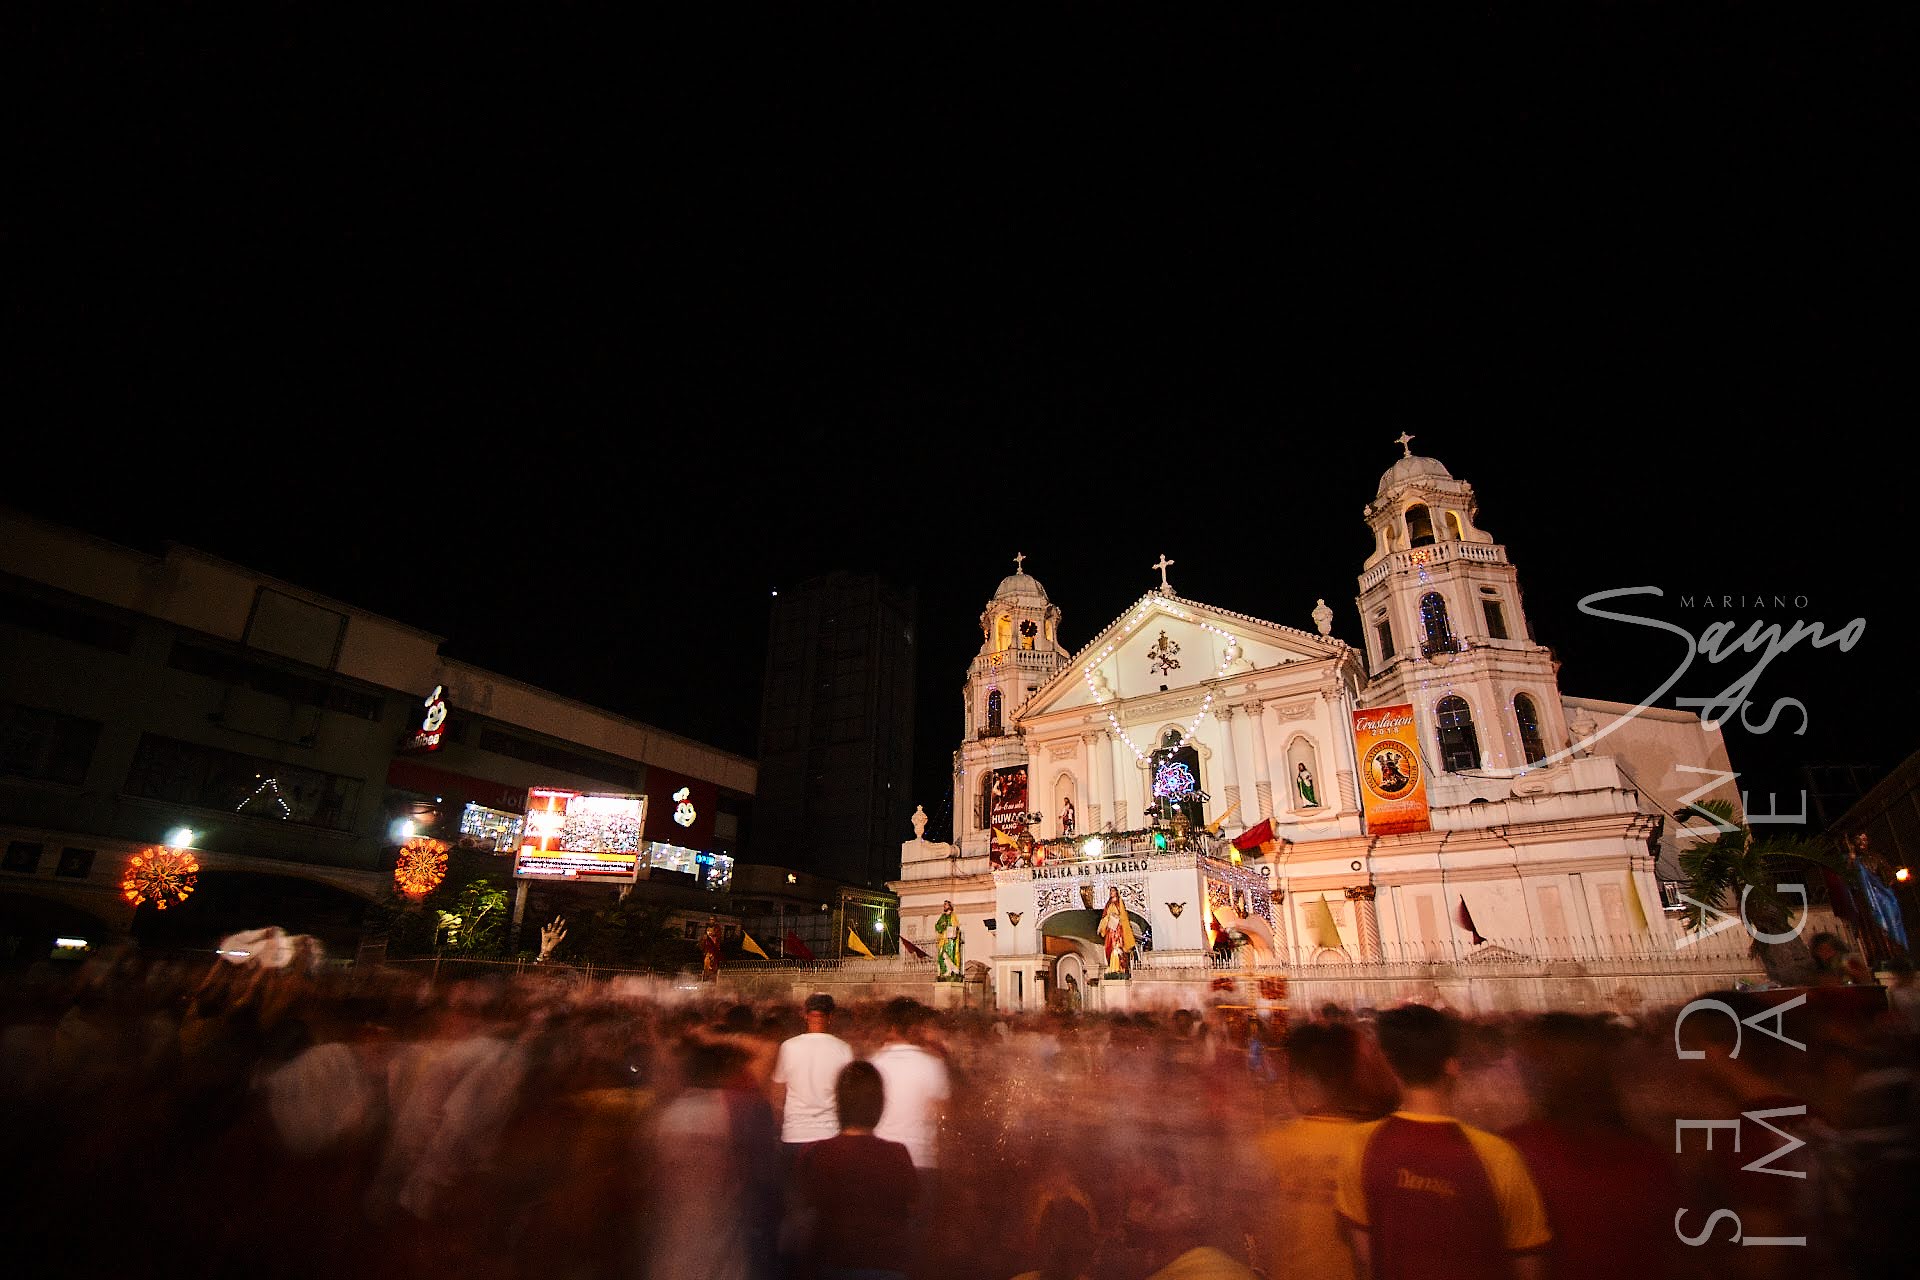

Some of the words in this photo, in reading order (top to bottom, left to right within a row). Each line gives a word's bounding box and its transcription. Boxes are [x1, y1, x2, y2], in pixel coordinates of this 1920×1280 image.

[1356, 711, 1412, 731] Traslacion
[1032, 867, 1072, 880] BASILIKA
[1078, 865, 1090, 876] NG
[1095, 860, 1148, 875] NAZARENO
